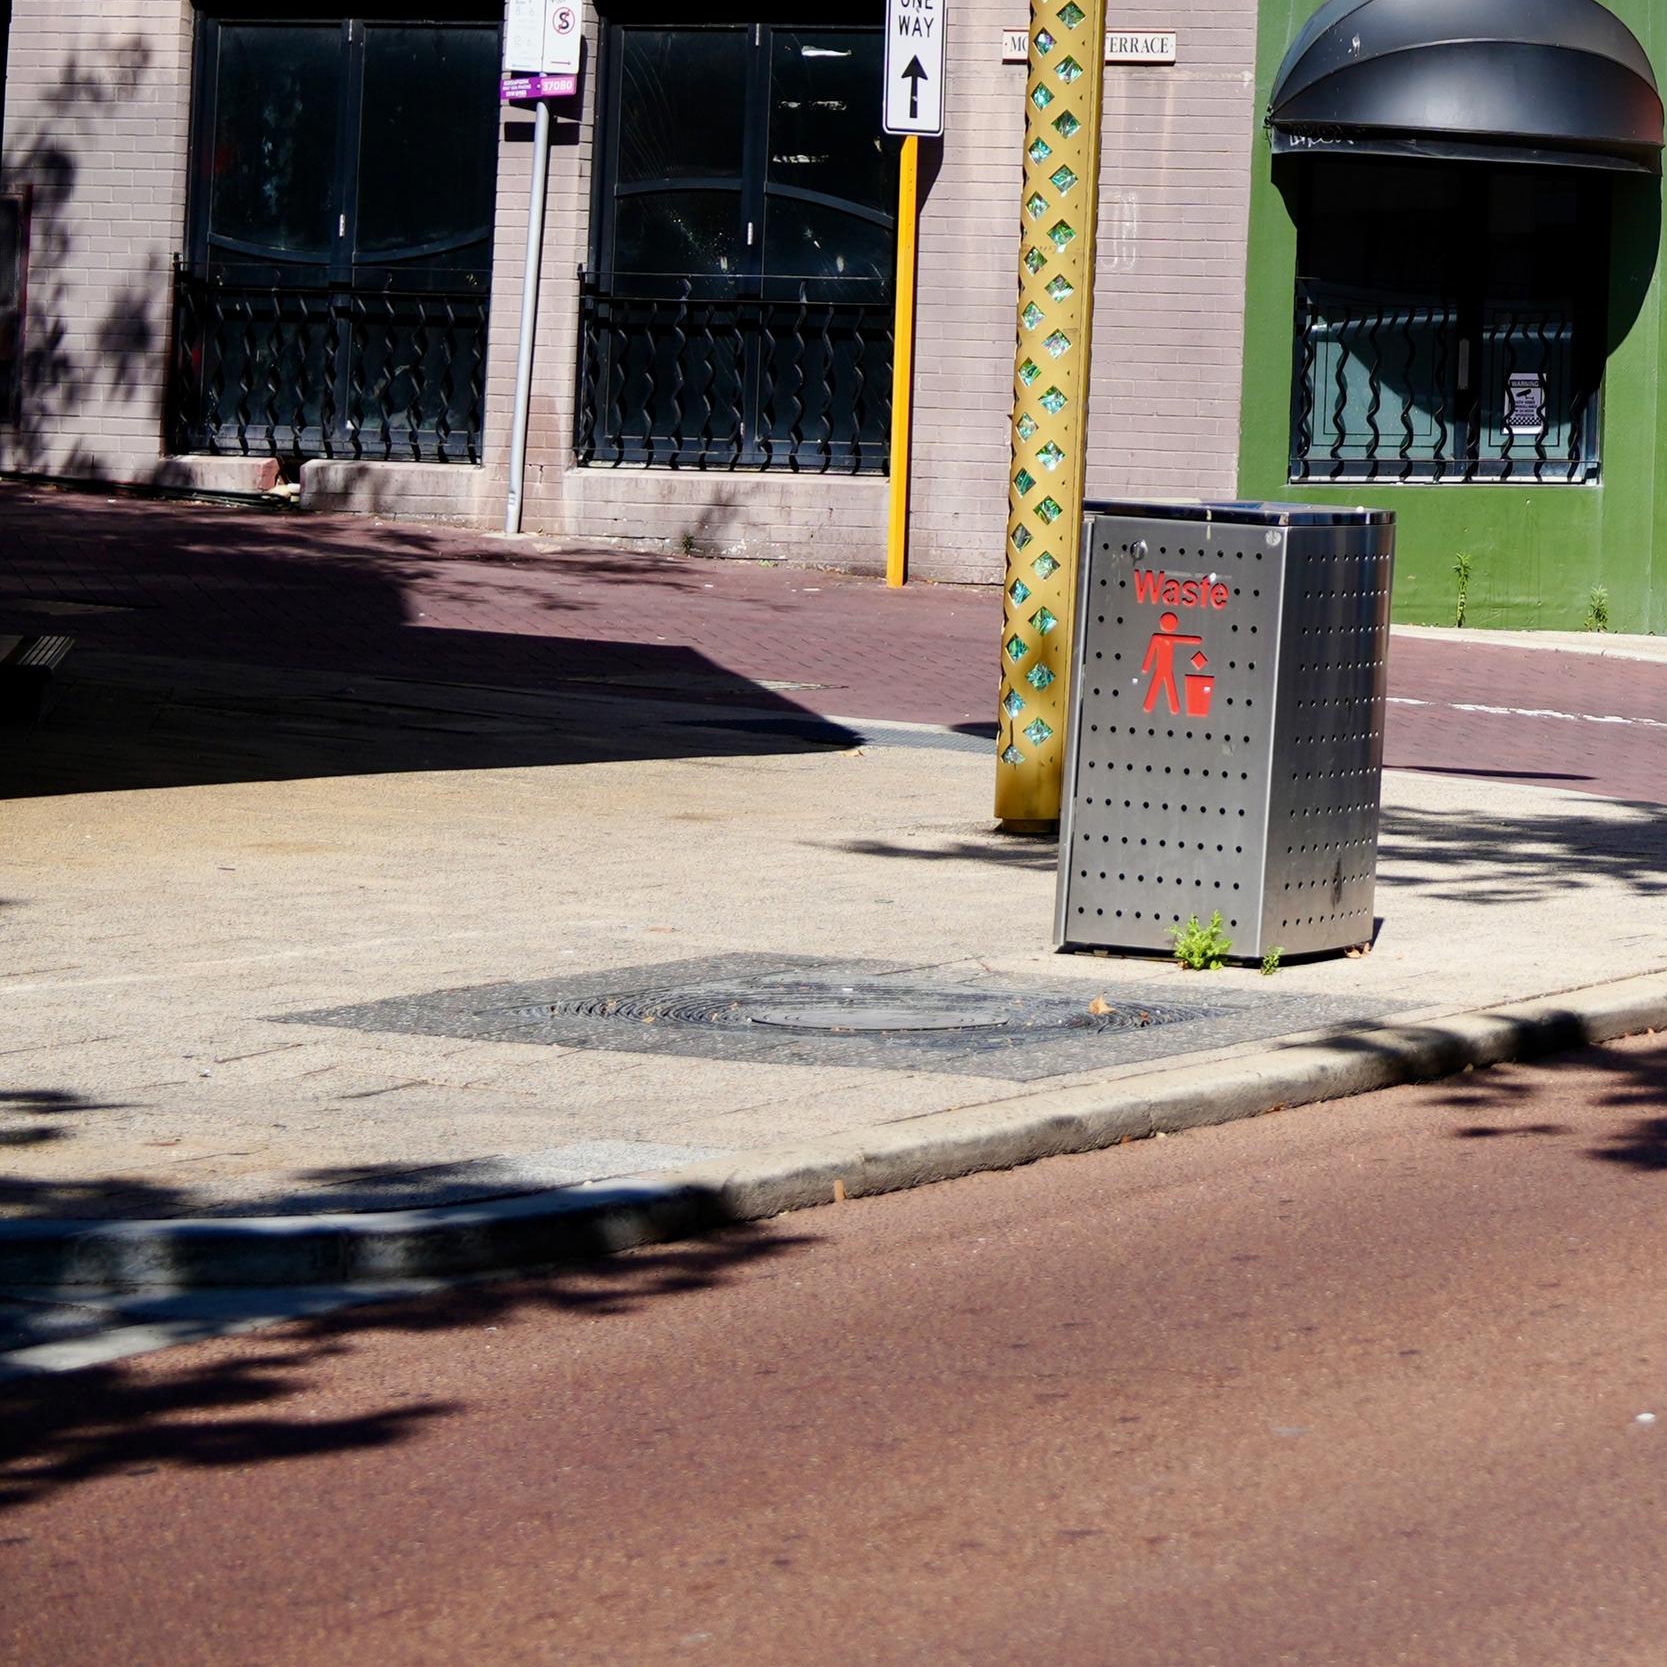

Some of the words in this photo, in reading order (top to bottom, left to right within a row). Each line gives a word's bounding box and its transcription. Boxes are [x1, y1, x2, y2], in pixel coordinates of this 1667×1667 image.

[898, 15, 935, 38] WAY
[1106, 36, 1169, 54] ERRACE
[542, 80, 573, 91] 37080
[1133, 568, 1229, 610] Waste
